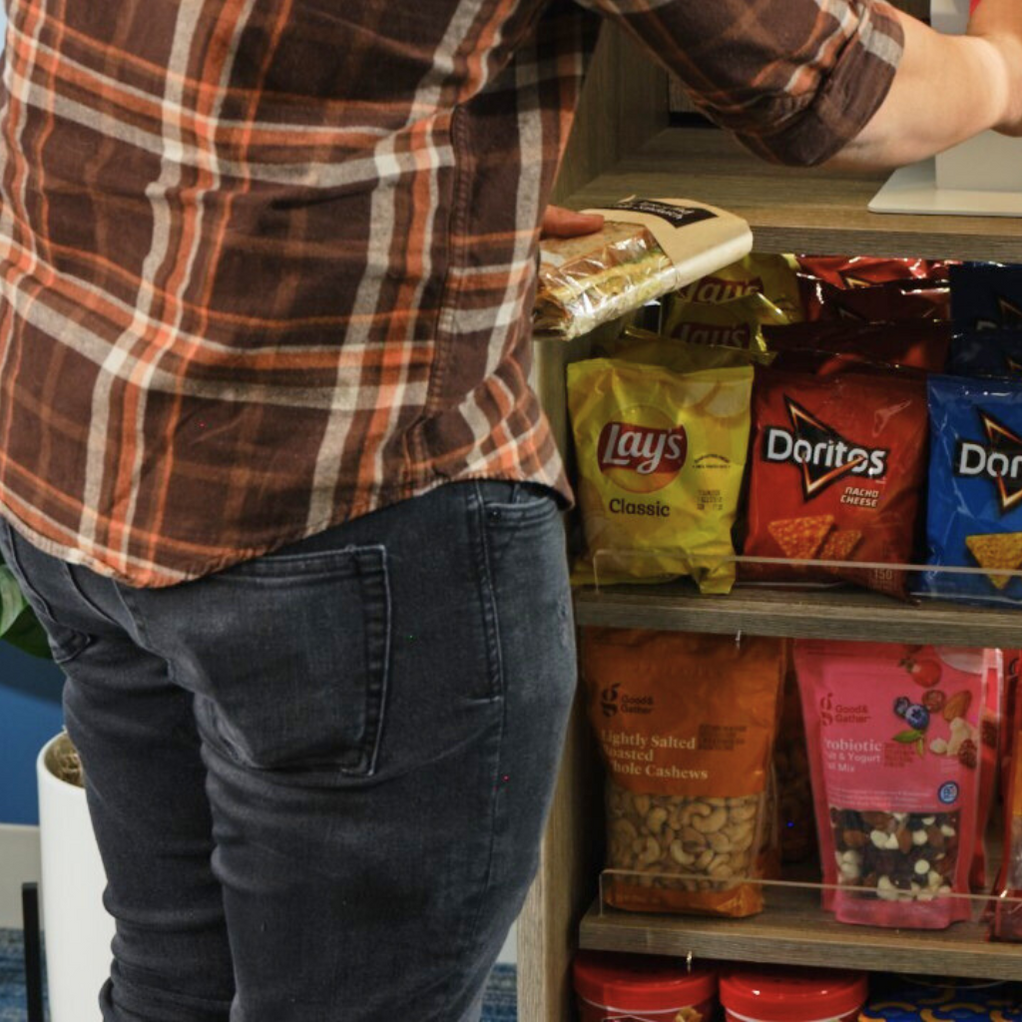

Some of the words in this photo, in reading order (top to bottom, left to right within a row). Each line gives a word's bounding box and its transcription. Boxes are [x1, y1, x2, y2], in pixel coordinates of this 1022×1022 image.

[603, 425, 684, 474] Lay's
[767, 428, 887, 476] Doritos
[840, 495, 879, 508] CHEESE
[845, 486, 880, 498] NACHO
[609, 498, 670, 517] Classic
[601, 729, 646, 749] Lightly
[651, 735, 697, 750] Salted
[825, 738, 882, 752] robiotic
[848, 752, 881, 764] Yogurt
[611, 760, 642, 775] hole
[645, 764, 708, 780] Cashews
